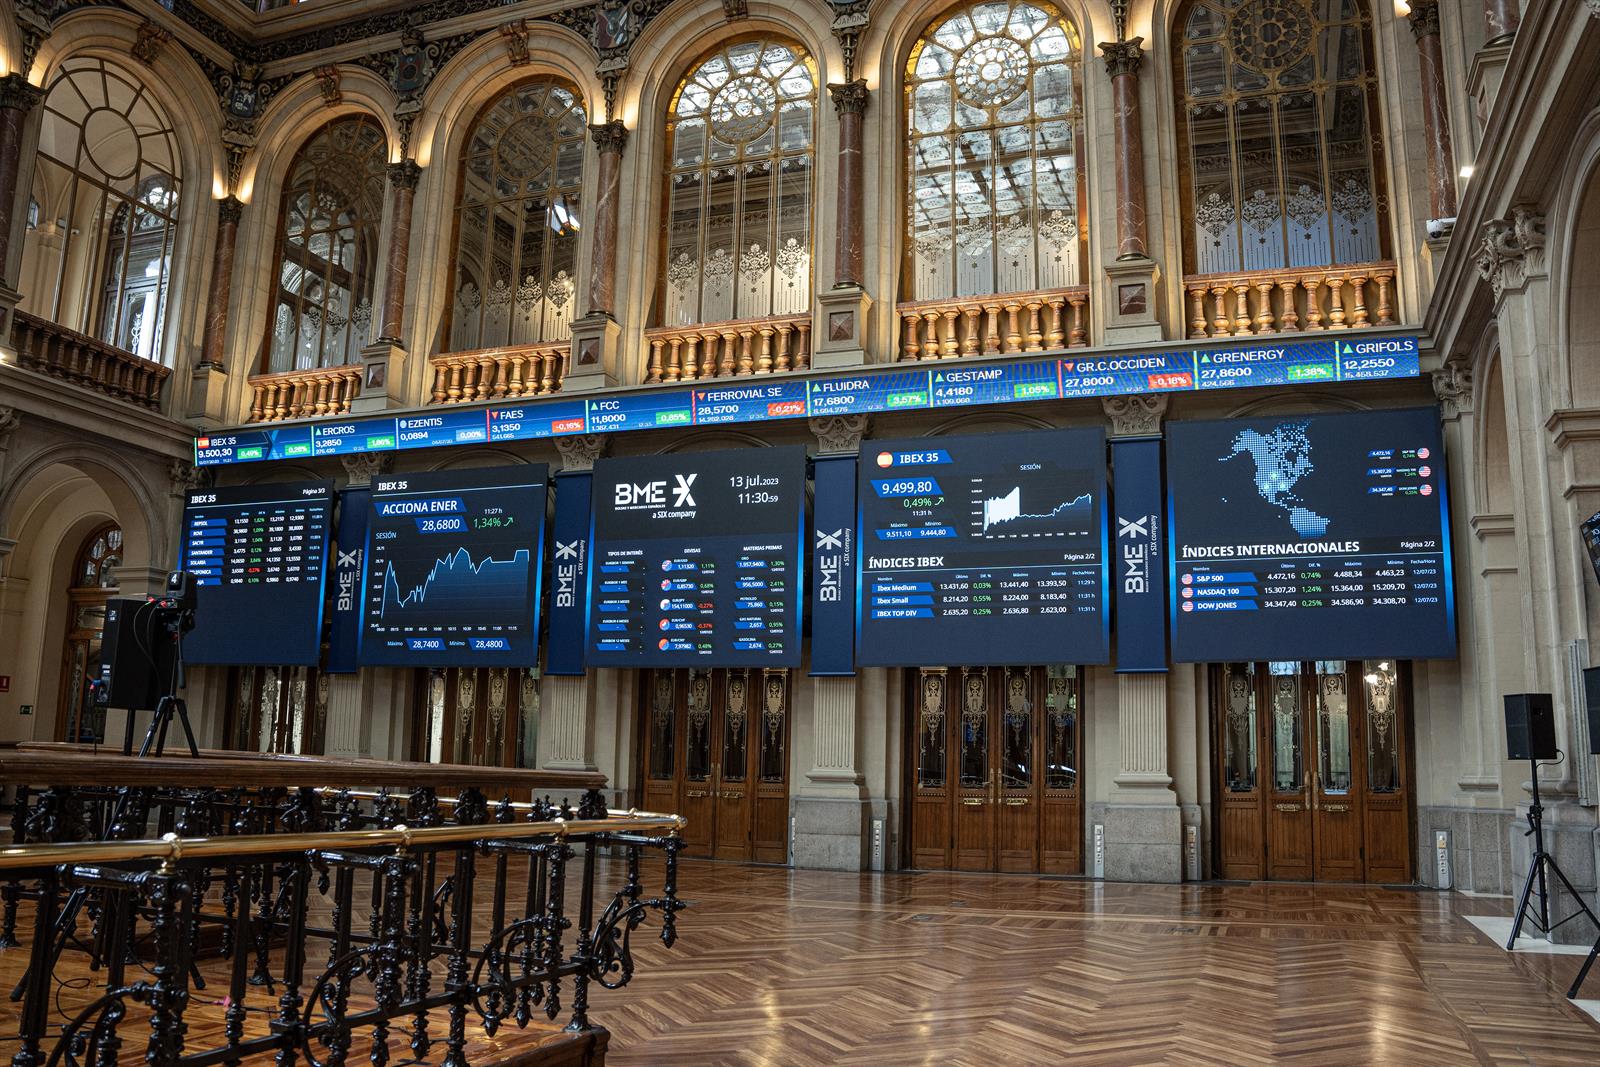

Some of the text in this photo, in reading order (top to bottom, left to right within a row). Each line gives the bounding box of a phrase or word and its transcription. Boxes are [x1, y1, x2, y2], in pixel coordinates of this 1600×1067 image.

[1356, 340, 1414, 354] GRIFOLS
[1213, 349, 1285, 363] GRENERGY
[1076, 357, 1166, 373] GR.C.OCCIDEN
[1343, 358, 1395, 370] 12,2550
[946, 369, 1003, 383] GESTAMP
[1201, 367, 1252, 379] 27,8600
[823, 380, 870, 392] FLUIDRA
[1065, 376, 1114, 388] 27,8000
[708, 387, 783, 402] FERROVIAL SE
[936, 387, 974, 398] 4,4180
[600, 401, 620, 411] FCC
[814, 395, 855, 407] 17,6800
[500, 409, 524, 421] FAES
[698, 404, 739, 416] 28,5700
[408, 417, 443, 428] EZENTIS
[591, 413, 626, 425] 11,8000
[322, 426, 355, 436] ERCROS
[492, 423, 521, 434] 3,1350
[210, 437, 237, 447] IBEX 35
[400, 431, 429, 442] 0,0894
[315, 439, 342, 448] 3,2850
[198, 448, 233, 459] 9.500,30
[900, 453, 939, 464] IBEX 35
[378, 481, 408, 491] IBEX 35
[730, 477, 743, 487] 13
[882, 481, 932, 495] 9.499,80
[191, 494, 217, 504] IBEX 35
[615, 481, 667, 506] BME
[382, 500, 458, 516] ACCIONA ENER
[903, 497, 932, 509] 0,49%
[668, 511, 697, 519] company
[422, 519, 460, 532] 28,6800
[473, 518, 501, 530] 1,34%
[1150, 514, 1158, 541] company
[886, 529, 912, 538] 9.511,10
[920, 528, 947, 537] 9.444,80
[1182, 541, 1360, 558] ÍNDICES INTERNACIONALES
[1400, 541, 1422, 549] Página
[869, 556, 944, 569] ÍNDICES IBEX
[1064, 554, 1084, 562] Página
[1124, 543, 1144, 593] BME
[820, 555, 838, 602] BME
[1268, 572, 1296, 581] 4.472,16
[1300, 571, 1322, 580] 0,74%
[1375, 568, 1405, 577] 4.463,23
[338, 571, 352, 611] BME
[557, 564, 573, 607] BME
[940, 581, 969, 591] 13.431,60
[1197, 588, 1226, 596] NASDAQ
[1264, 585, 1297, 595] 15.307,20
[1302, 585, 1322, 594] 1,24%
[1331, 583, 1364, 592] 15.364,00
[1372, 582, 1406, 591] 15.209,70
[891, 596, 909, 604] Small
[943, 594, 969, 604] 8.214,20
[1003, 593, 1029, 602] 8.224,00
[1040, 592, 1067, 601] 8.183,40
[1213, 602, 1237, 610] JONES
[1264, 599, 1297, 609] 34.347,40
[1302, 599, 1322, 608] 0,25%
[1373, 596, 1406, 606] 34.308,70
[943, 608, 969, 617] 2.635,20
[1040, 606, 1067, 614] 2.623,00
[413, 640, 440, 650] 28,7400
[475, 640, 504, 649] 28,4800
